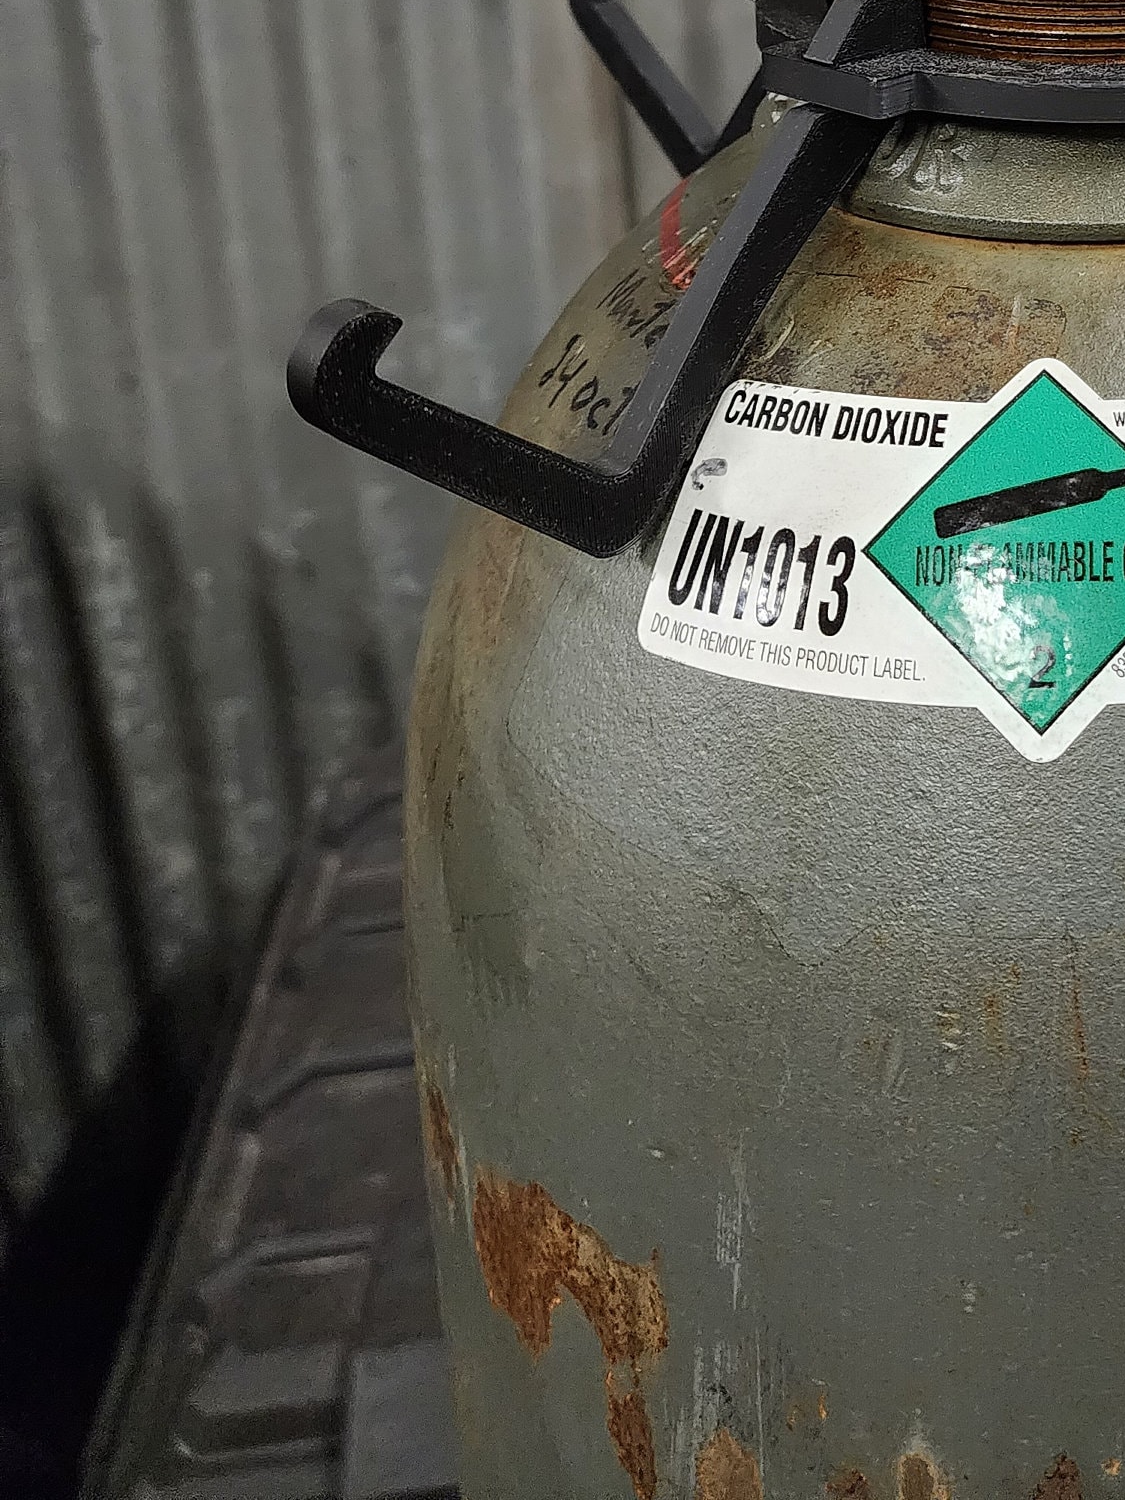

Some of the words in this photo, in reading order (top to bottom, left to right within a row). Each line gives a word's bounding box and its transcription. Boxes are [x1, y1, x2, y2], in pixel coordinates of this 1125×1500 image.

[724, 390, 830, 437] CARBON
[832, 405, 949, 448] DIOXIDE
[668, 507, 857, 637] UN1013
[915, 540, 1115, 587] NONAMMABLE
[650, 612, 669, 637] DO
[670, 621, 698, 646] NOT
[699, 630, 757, 660] REMOVE
[759, 641, 792, 667] THIS
[795, 647, 869, 677] PRODUCT
[873, 656, 926, 682] LABEL.
[1028, 645, 1057, 689] 2
